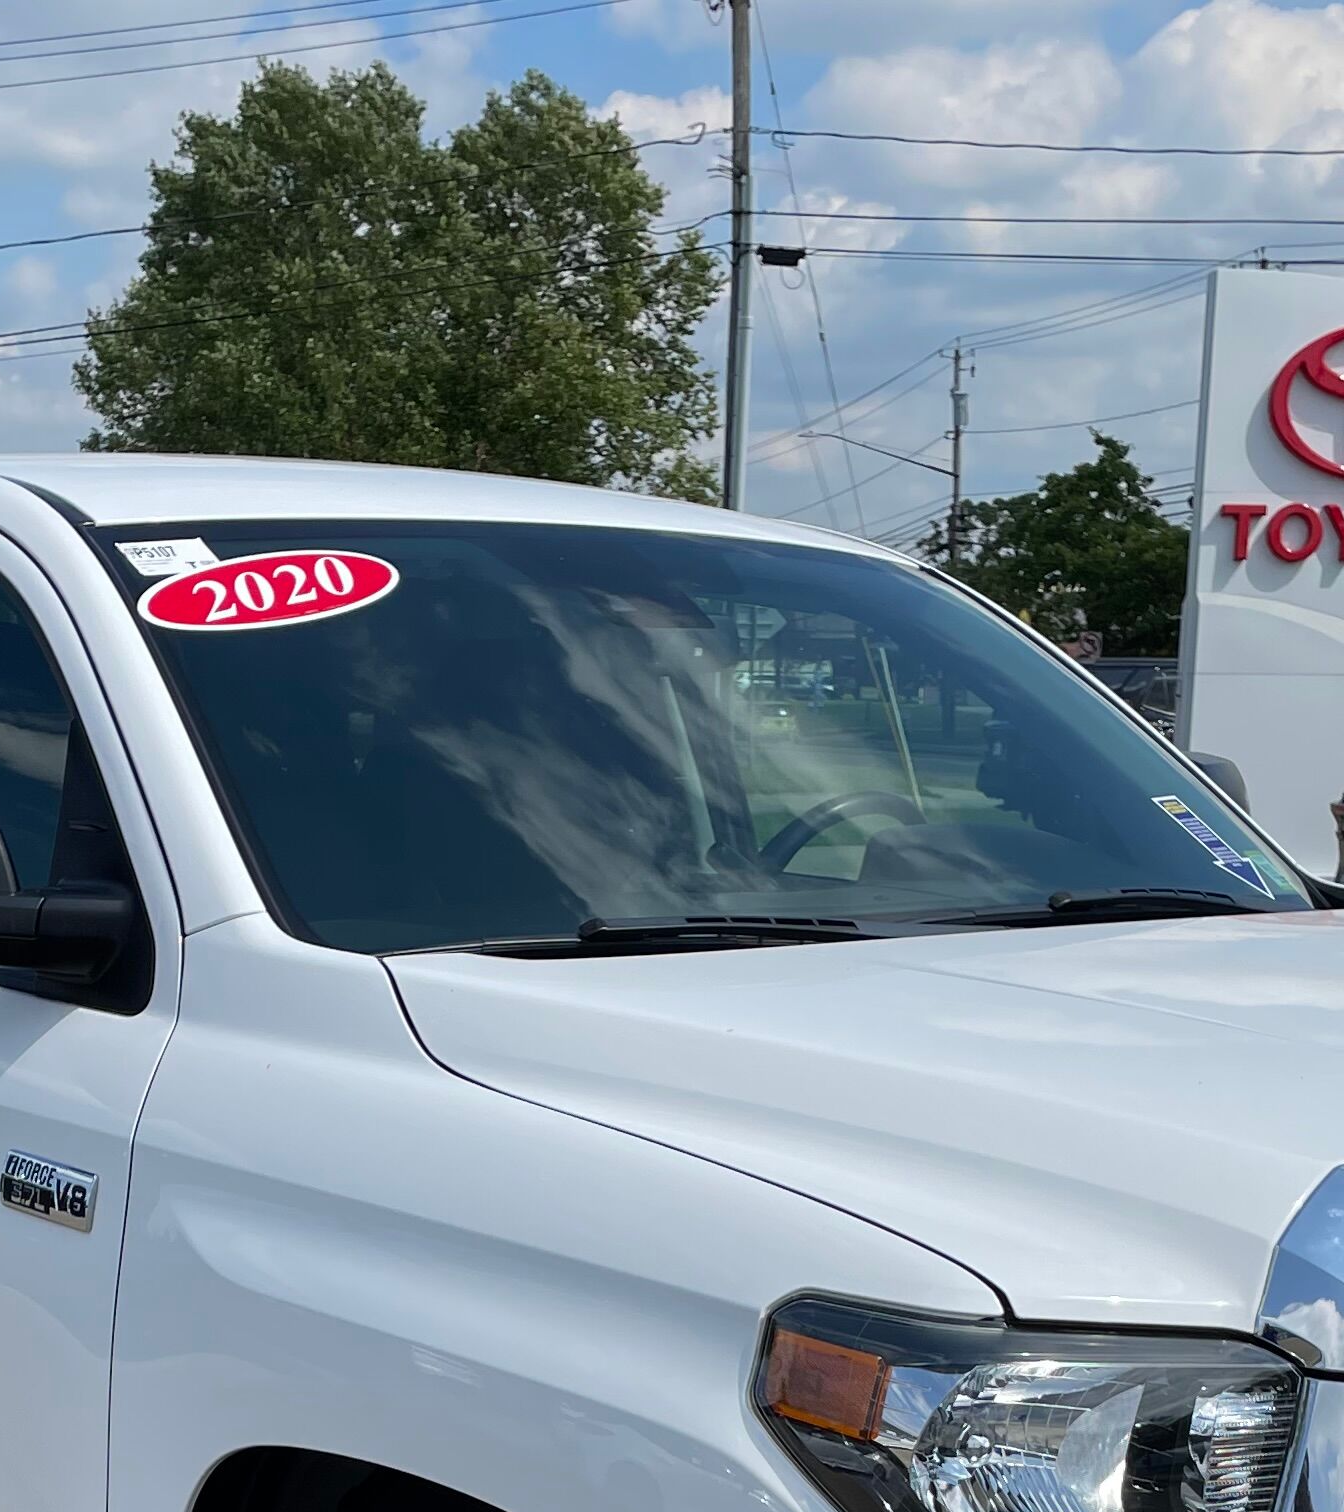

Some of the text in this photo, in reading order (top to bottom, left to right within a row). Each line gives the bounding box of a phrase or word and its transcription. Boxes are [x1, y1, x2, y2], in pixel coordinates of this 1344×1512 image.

[133, 545, 177, 559] P5107
[191, 556, 354, 623] 2020
[56, 1178, 87, 1218] V8
